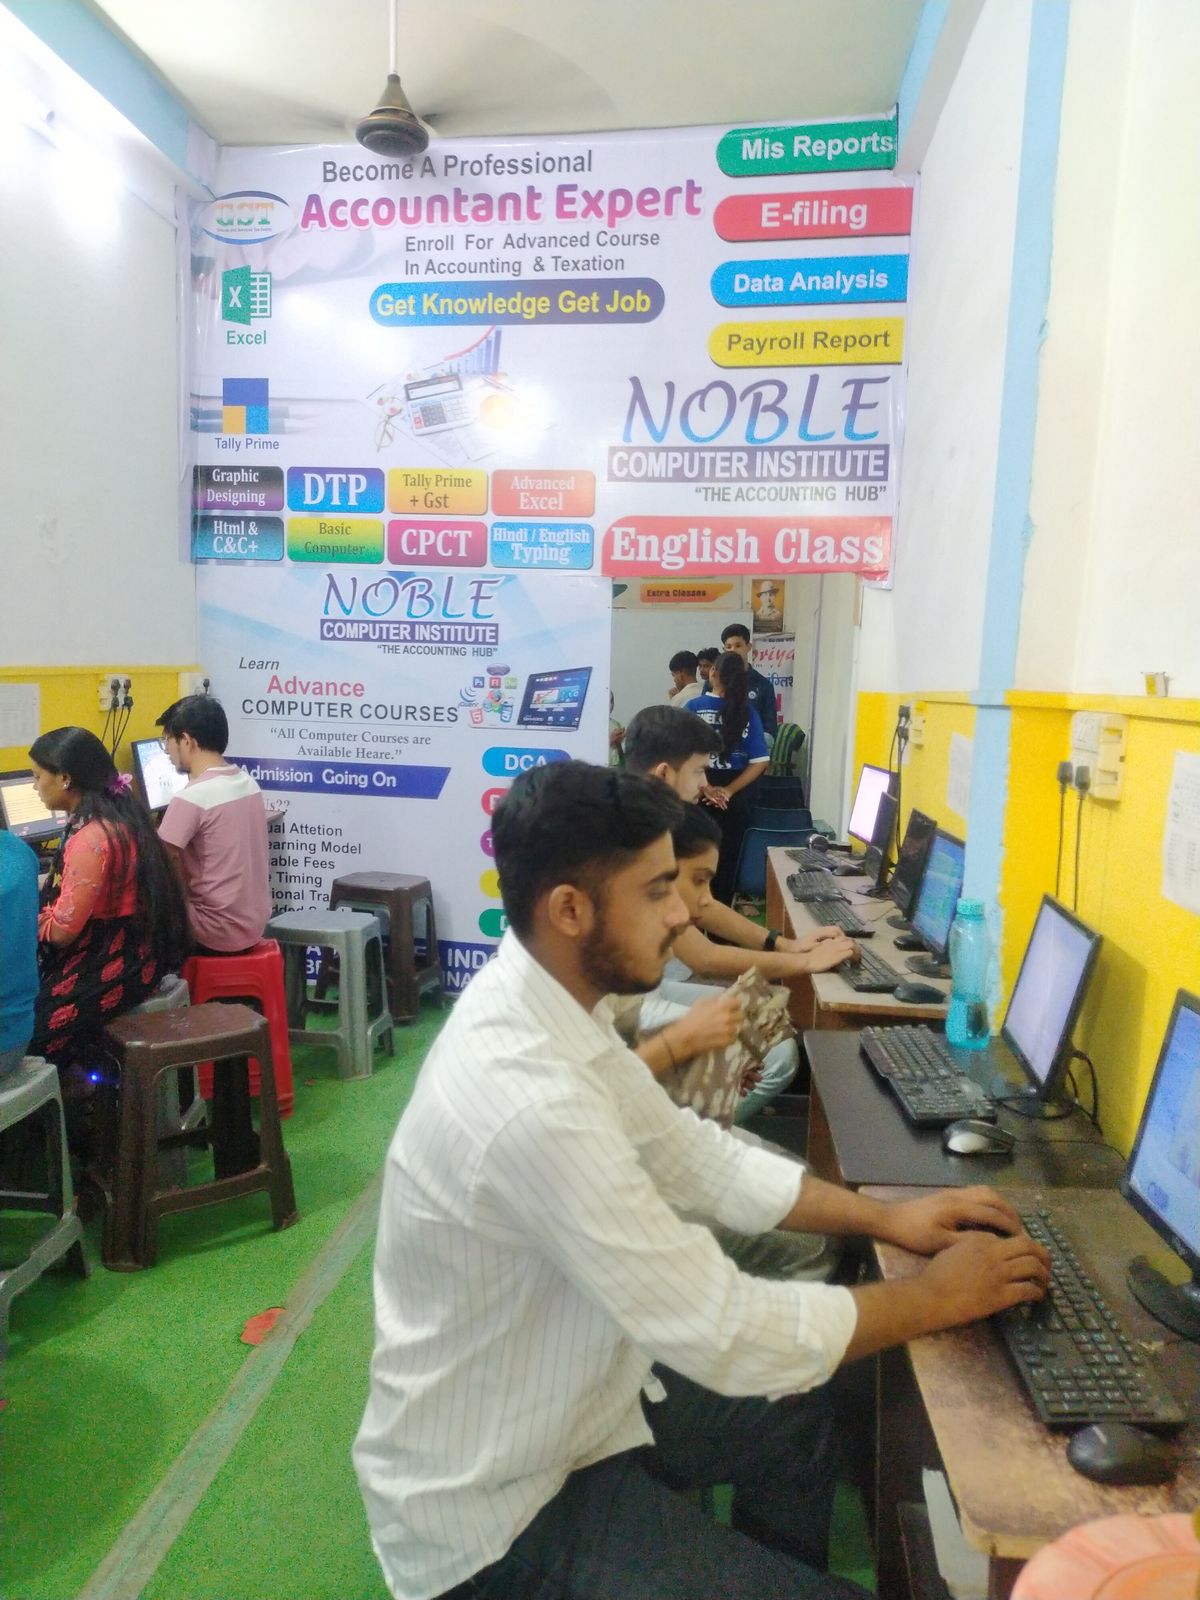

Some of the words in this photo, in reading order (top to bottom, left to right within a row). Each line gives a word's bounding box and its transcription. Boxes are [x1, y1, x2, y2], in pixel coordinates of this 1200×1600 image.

[741, 136, 785, 161] Mis
[793, 131, 894, 161] Reports
[322, 159, 414, 183] Become
[419, 155, 437, 178] A
[443, 150, 593, 177] Professional
[301, 185, 543, 229] Accountant
[555, 179, 704, 229] Expert
[760, 199, 868, 230] E-filing
[405, 235, 455, 252] Enroll
[465, 235, 494, 251] For
[503, 231, 590, 250] Advanced
[596, 230, 660, 248] Course
[405, 259, 419, 276] In
[424, 257, 522, 277] Accounting
[533, 257, 545, 273] &
[551, 254, 626, 272] Texation
[733, 273, 784, 293] Data
[789, 269, 889, 294] Analysis
[376, 293, 418, 317] Get
[422, 291, 550, 319] Knowledge
[558, 290, 599, 315] Get
[605, 289, 651, 314] Job
[226, 330, 267, 345] Excel
[727, 332, 805, 354] Payroll
[812, 329, 890, 352] Report
[621, 373, 892, 445] NOBLE
[214, 437, 242, 452] Tally
[245, 437, 279, 450] Prime
[611, 450, 749, 479] COMPUTER
[755, 449, 885, 478] INSTITUTE
[211, 468, 260, 484] Graphic
[402, 474, 432, 491] Tally
[435, 474, 472, 488] Prime
[511, 475, 576, 490] Advanced
[206, 488, 266, 507] Designing
[303, 472, 368, 506] DTP
[735, 486, 836, 502] ACCOUNTING
[423, 491, 450, 509] Gst
[519, 492, 565, 511] Excel
[213, 520, 245, 535] Html
[247, 520, 259, 535] &
[318, 521, 352, 536] Basic
[492, 527, 529, 542] Hindi
[539, 528, 590, 546] English
[212, 537, 259, 555] C&C+
[303, 541, 366, 558] Computer
[400, 528, 473, 558] CPCT
[609, 526, 760, 570] English
[773, 526, 884, 565] Class
[510, 542, 572, 565] Typing
[323, 573, 506, 620] NOBLE
[322, 622, 411, 641] COMPUTER
[414, 624, 497, 643] INSTITUTE
[402, 645, 467, 657] ACCOUNTING
[238, 657, 280, 671] Learn
[266, 675, 365, 698] Advance
[241, 699, 353, 720] COMPUTER
[359, 703, 459, 723] COURSES
[297, 728, 358, 745] Computer
[361, 731, 410, 745] Courses
[412, 735, 432, 745] are
[297, 745, 352, 758] Available
[504, 753, 548, 772] DCA
[322, 769, 369, 789] Going
[372, 771, 397, 788] On
[290, 822, 343, 837] Attetion
[321, 841, 362, 855] Model
[304, 857, 336, 870] Fees
[276, 871, 323, 888] Timing
